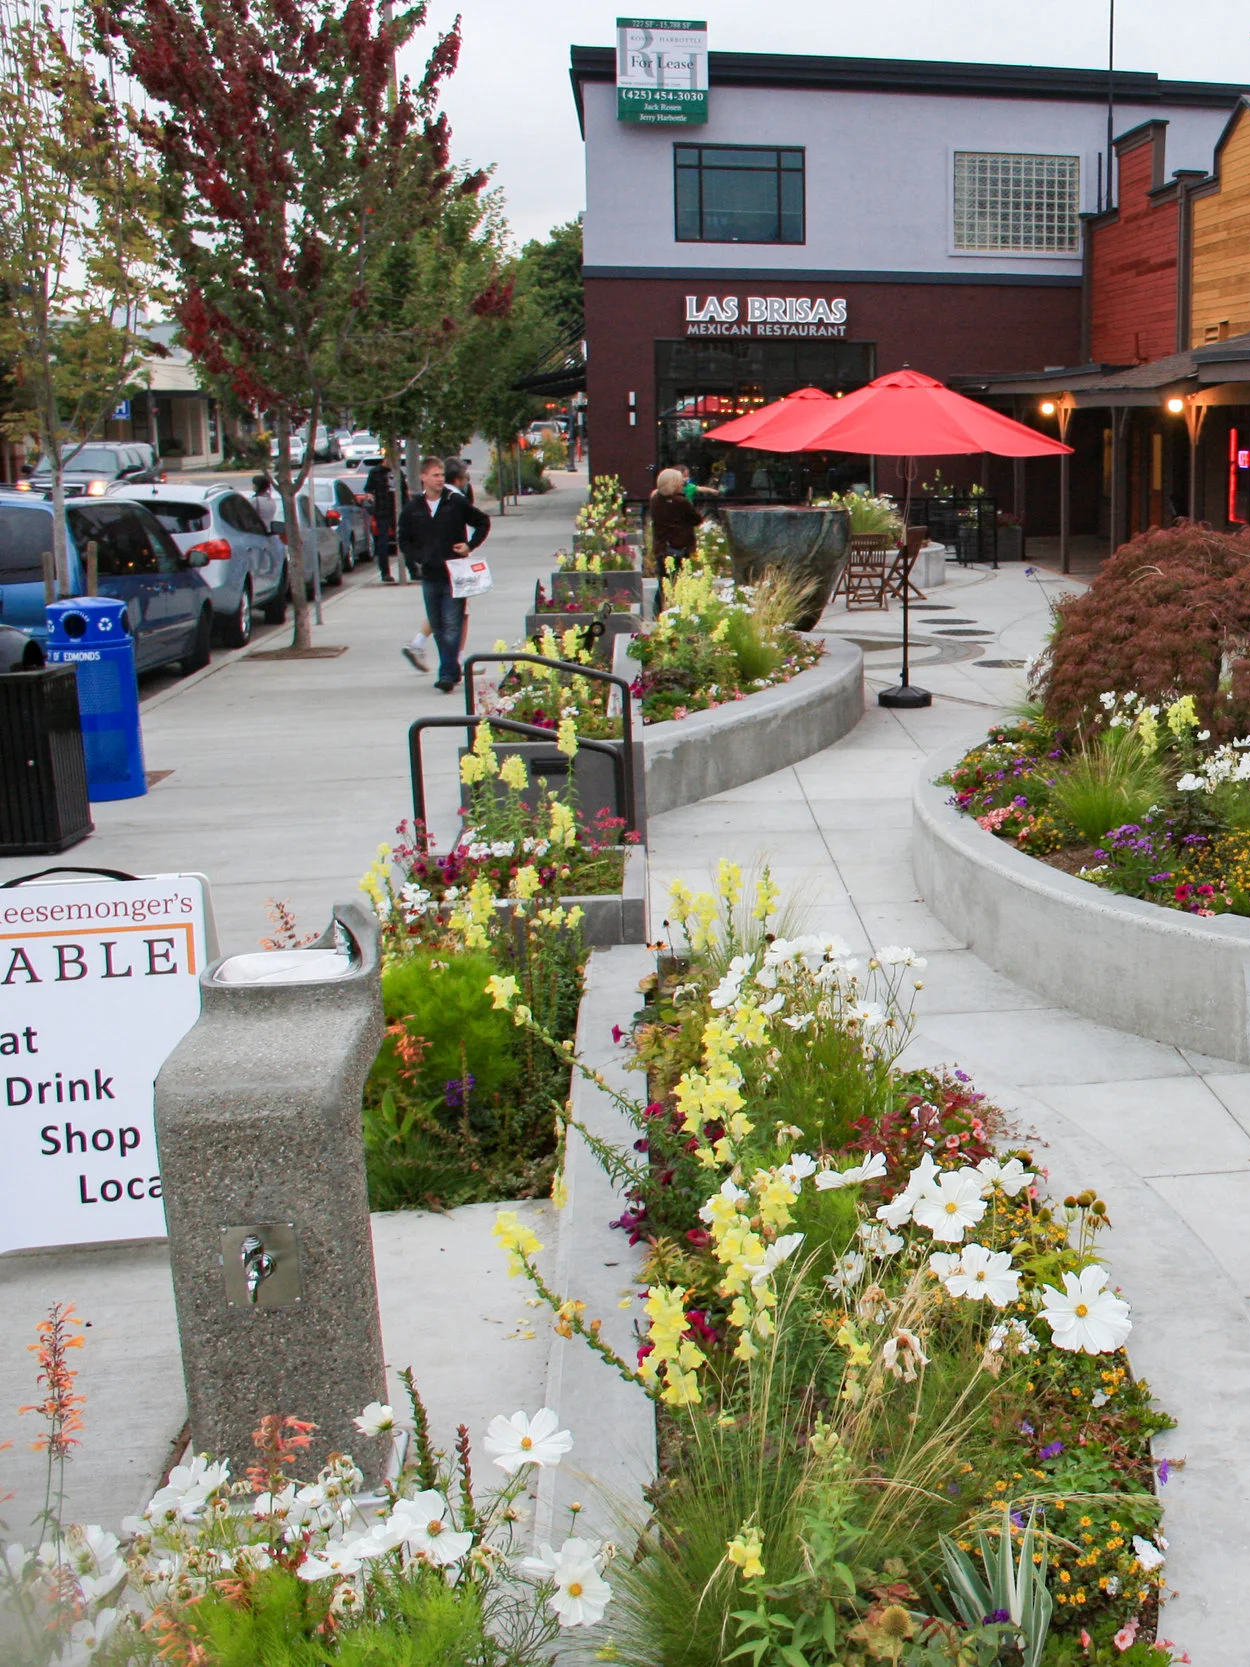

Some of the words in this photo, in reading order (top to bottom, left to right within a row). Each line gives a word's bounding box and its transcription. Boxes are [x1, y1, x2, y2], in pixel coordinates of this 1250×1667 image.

[645, 20, 654, 28] SF
[631, 55, 653, 68] For
[657, 56, 695, 69] Lease
[622, 89, 652, 101] (425)
[654, 91, 704, 102] 454-3030
[644, 103, 659, 111] Jack
[660, 103, 682, 111] Rosen
[639, 114, 655, 122] Jerry
[685, 295, 739, 322] LAS
[747, 297, 848, 323] BRISAS
[687, 324, 751, 336] MEXICAN
[756, 325, 847, 337] RESTAURANT
[63, 651, 101, 662] EDMONDS
[0, 893, 194, 924] eesemonger's
[1, 937, 178, 985] ABLE
[0, 1026, 39, 1056] at
[6, 1068, 116, 1107] Drink
[40, 1122, 141, 1157] Shop
